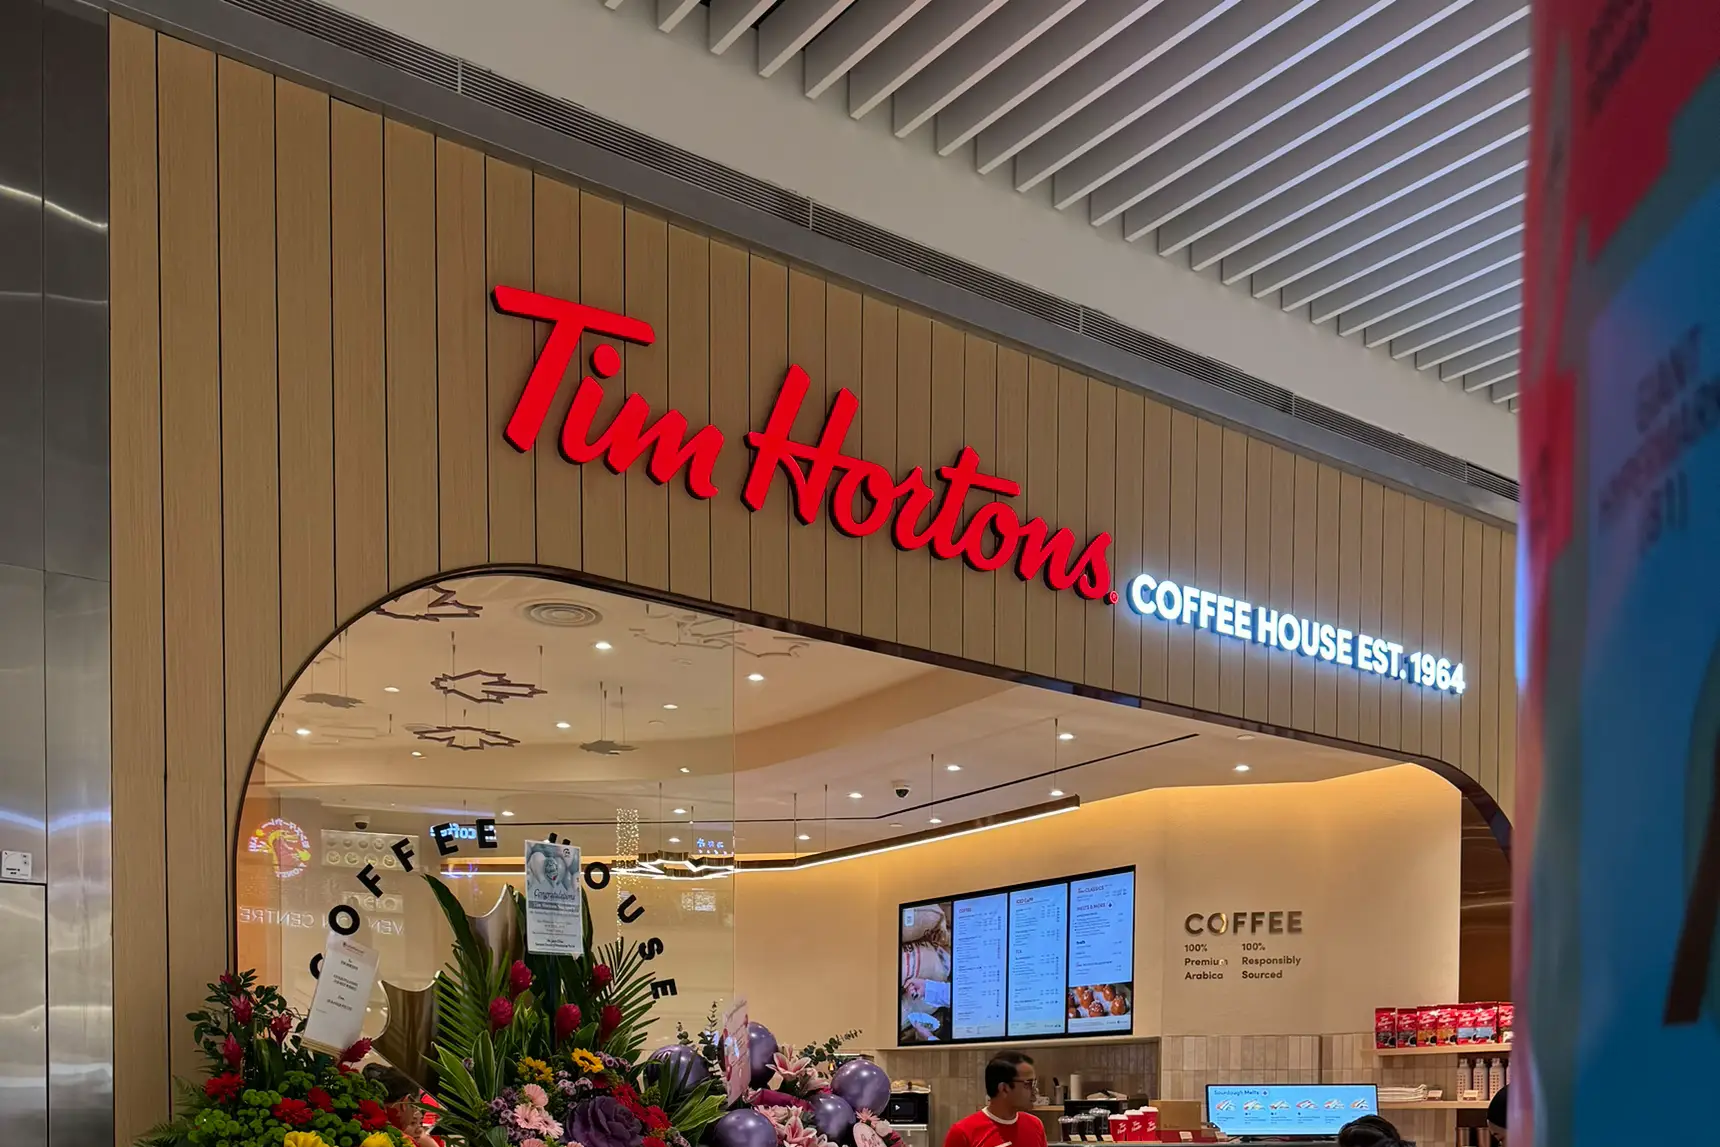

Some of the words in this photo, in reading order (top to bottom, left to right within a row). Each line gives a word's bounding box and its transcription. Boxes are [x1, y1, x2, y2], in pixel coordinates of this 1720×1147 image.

[491, 285, 724, 499] Tim
[740, 363, 1112, 600] Hortons
[1129, 574, 1252, 640] COFFEE
[1256, 606, 1353, 666] HOUSE
[1356, 635, 1406, 680] EST.
[1409, 651, 1466, 694] 1964
[1185, 911, 1302, 934] COFFEE
[1184, 944, 1208, 952] 100%
[1242, 943, 1266, 951] 100%
[1242, 956, 1301, 967] Responsibly
[1185, 972, 1223, 980] Arabica
[1242, 971, 1282, 979] Sourced
